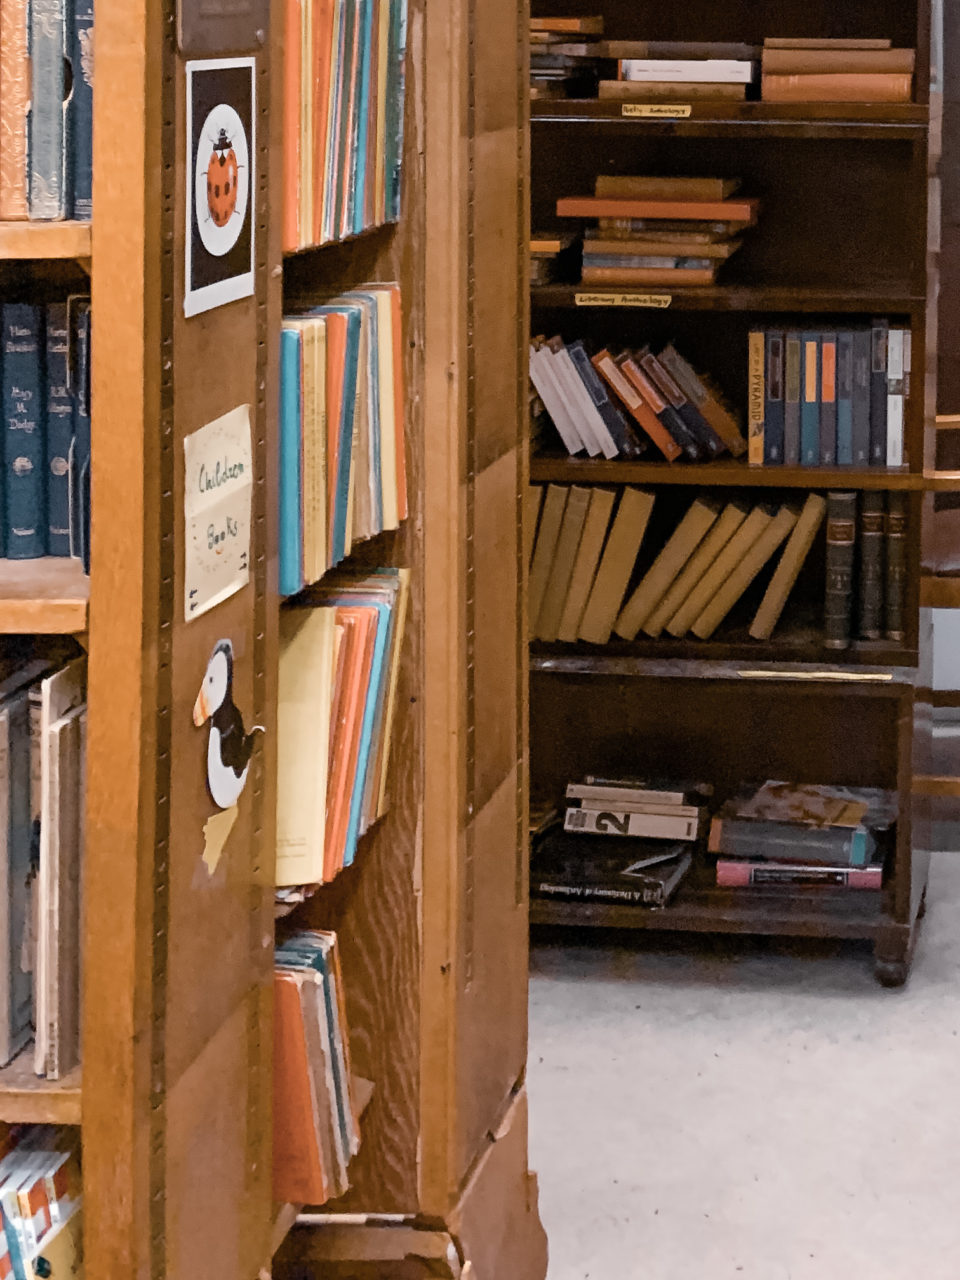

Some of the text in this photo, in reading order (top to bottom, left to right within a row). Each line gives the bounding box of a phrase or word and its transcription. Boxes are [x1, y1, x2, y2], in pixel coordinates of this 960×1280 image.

[752, 374, 761, 421] PYRAMID
[207, 516, 238, 550] Books
[596, 812, 631, 835] 2
